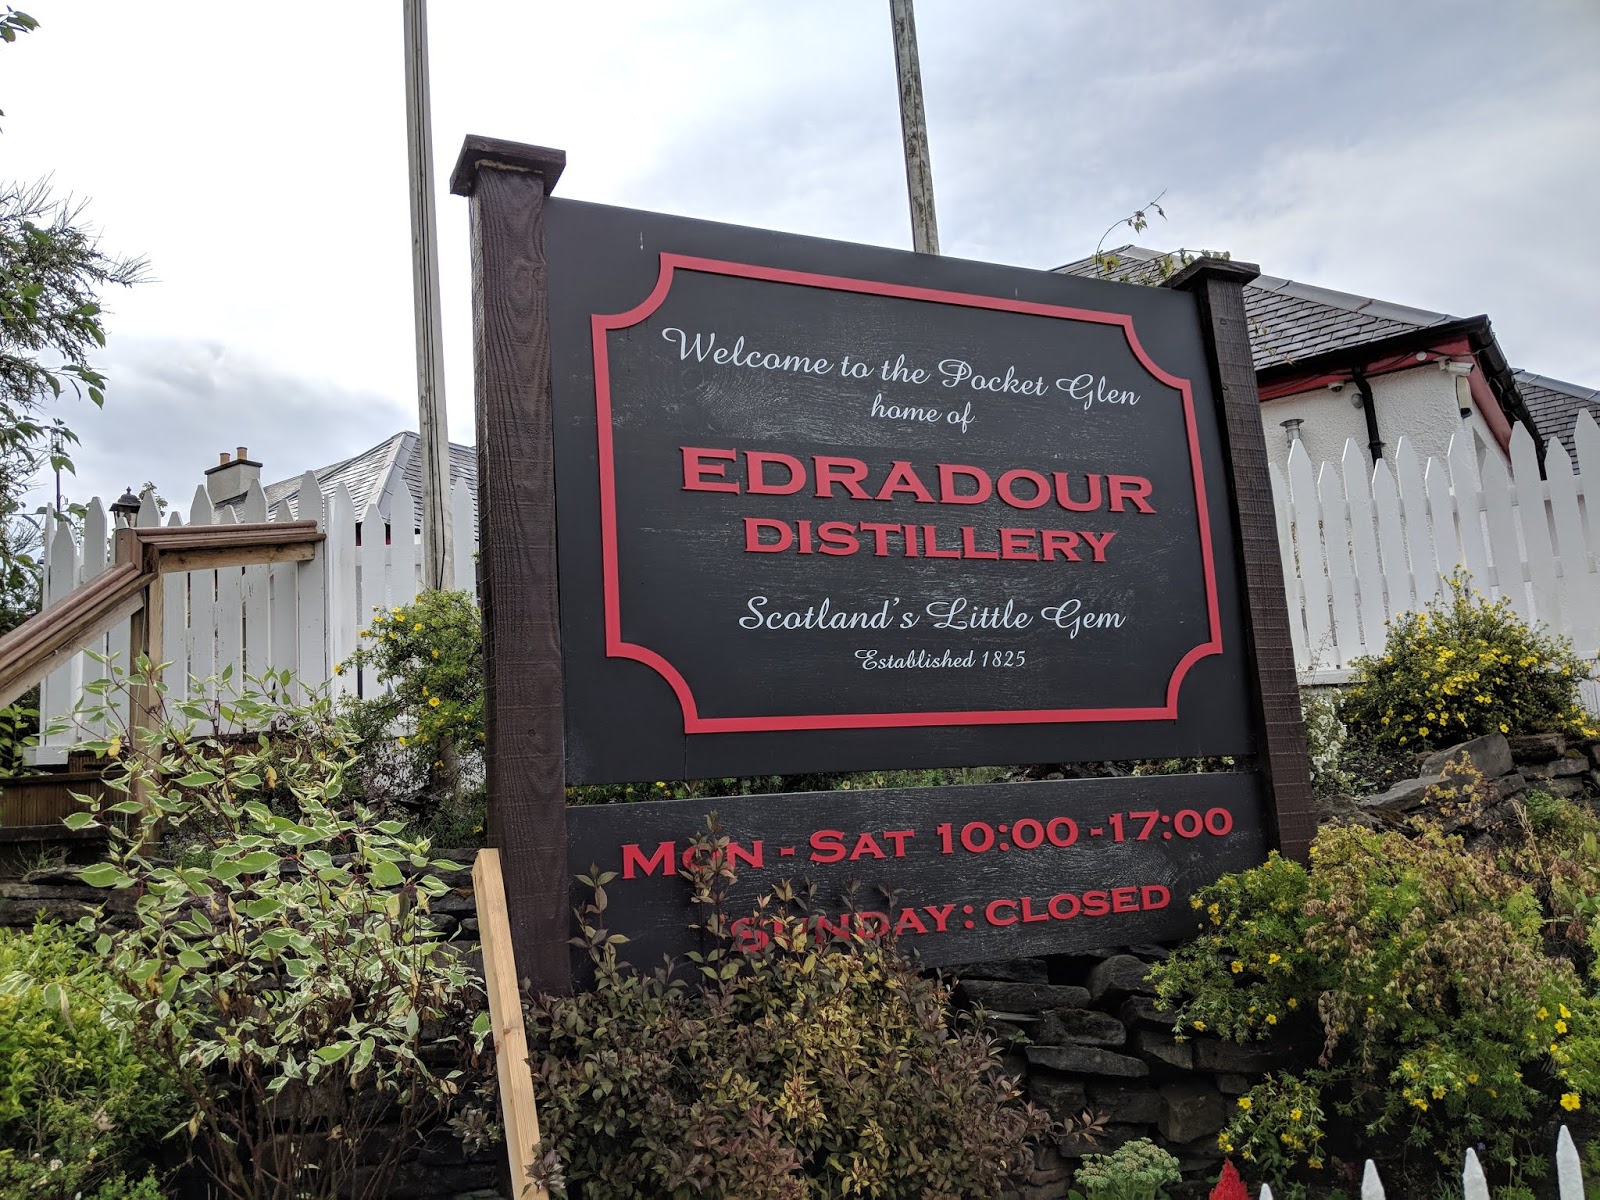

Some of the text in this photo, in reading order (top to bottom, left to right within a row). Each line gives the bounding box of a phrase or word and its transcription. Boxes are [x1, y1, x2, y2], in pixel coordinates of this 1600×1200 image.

[661, 327, 1141, 411] Welcome to the Pocket Glen
[870, 392, 976, 434] home of
[679, 446, 1157, 514] EDRADOUR
[743, 517, 1117, 562] DISTILLERY
[738, 595, 1127, 640] Scotland's Little Gem
[854, 648, 1026, 670] Established 1825
[809, 829, 915, 863] SAT
[936, 816, 1079, 854] 10:00
[985, 884, 1171, 926] CLOSED
